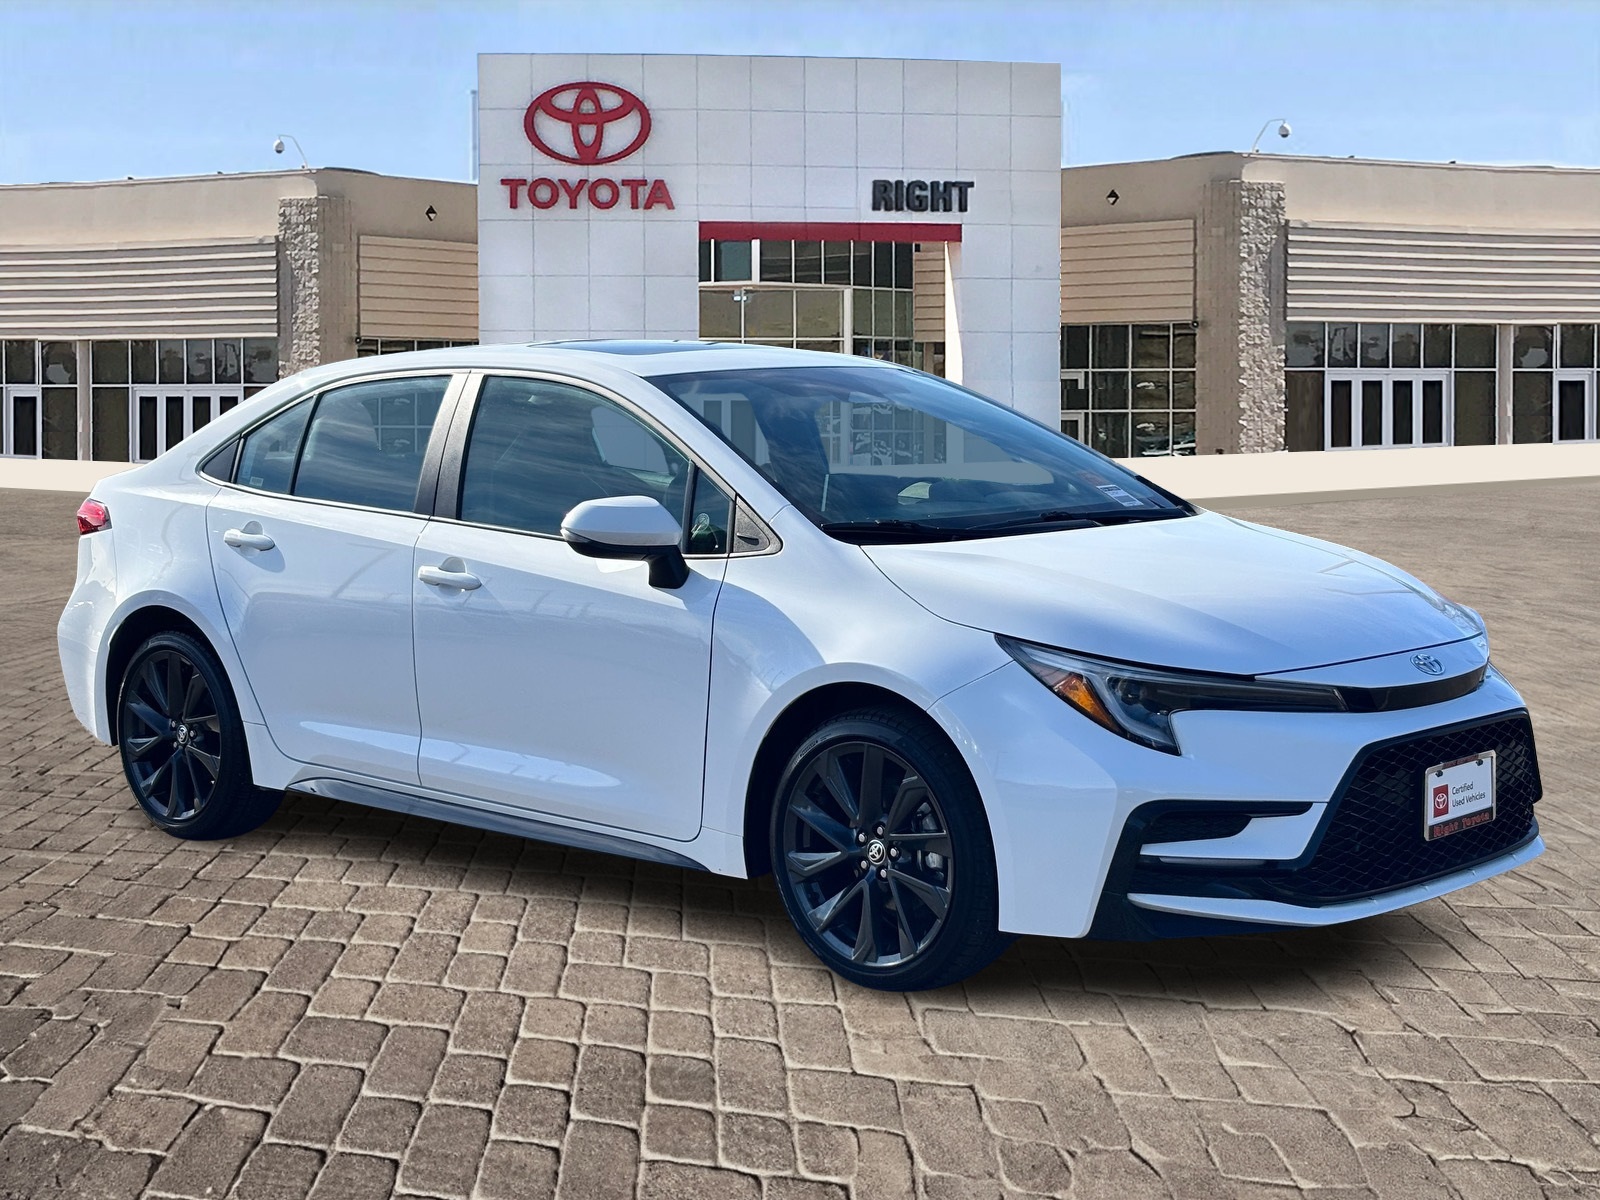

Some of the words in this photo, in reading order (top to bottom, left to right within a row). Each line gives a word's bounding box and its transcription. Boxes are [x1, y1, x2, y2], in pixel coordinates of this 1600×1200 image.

[501, 178, 675, 210] TOYOTA
[872, 180, 975, 212] RIGHT
[1452, 781, 1473, 795] Certified
[1452, 796, 1465, 807] Used
[1466, 791, 1486, 804] Vehicles
[1462, 812, 1490, 828] Toyota
